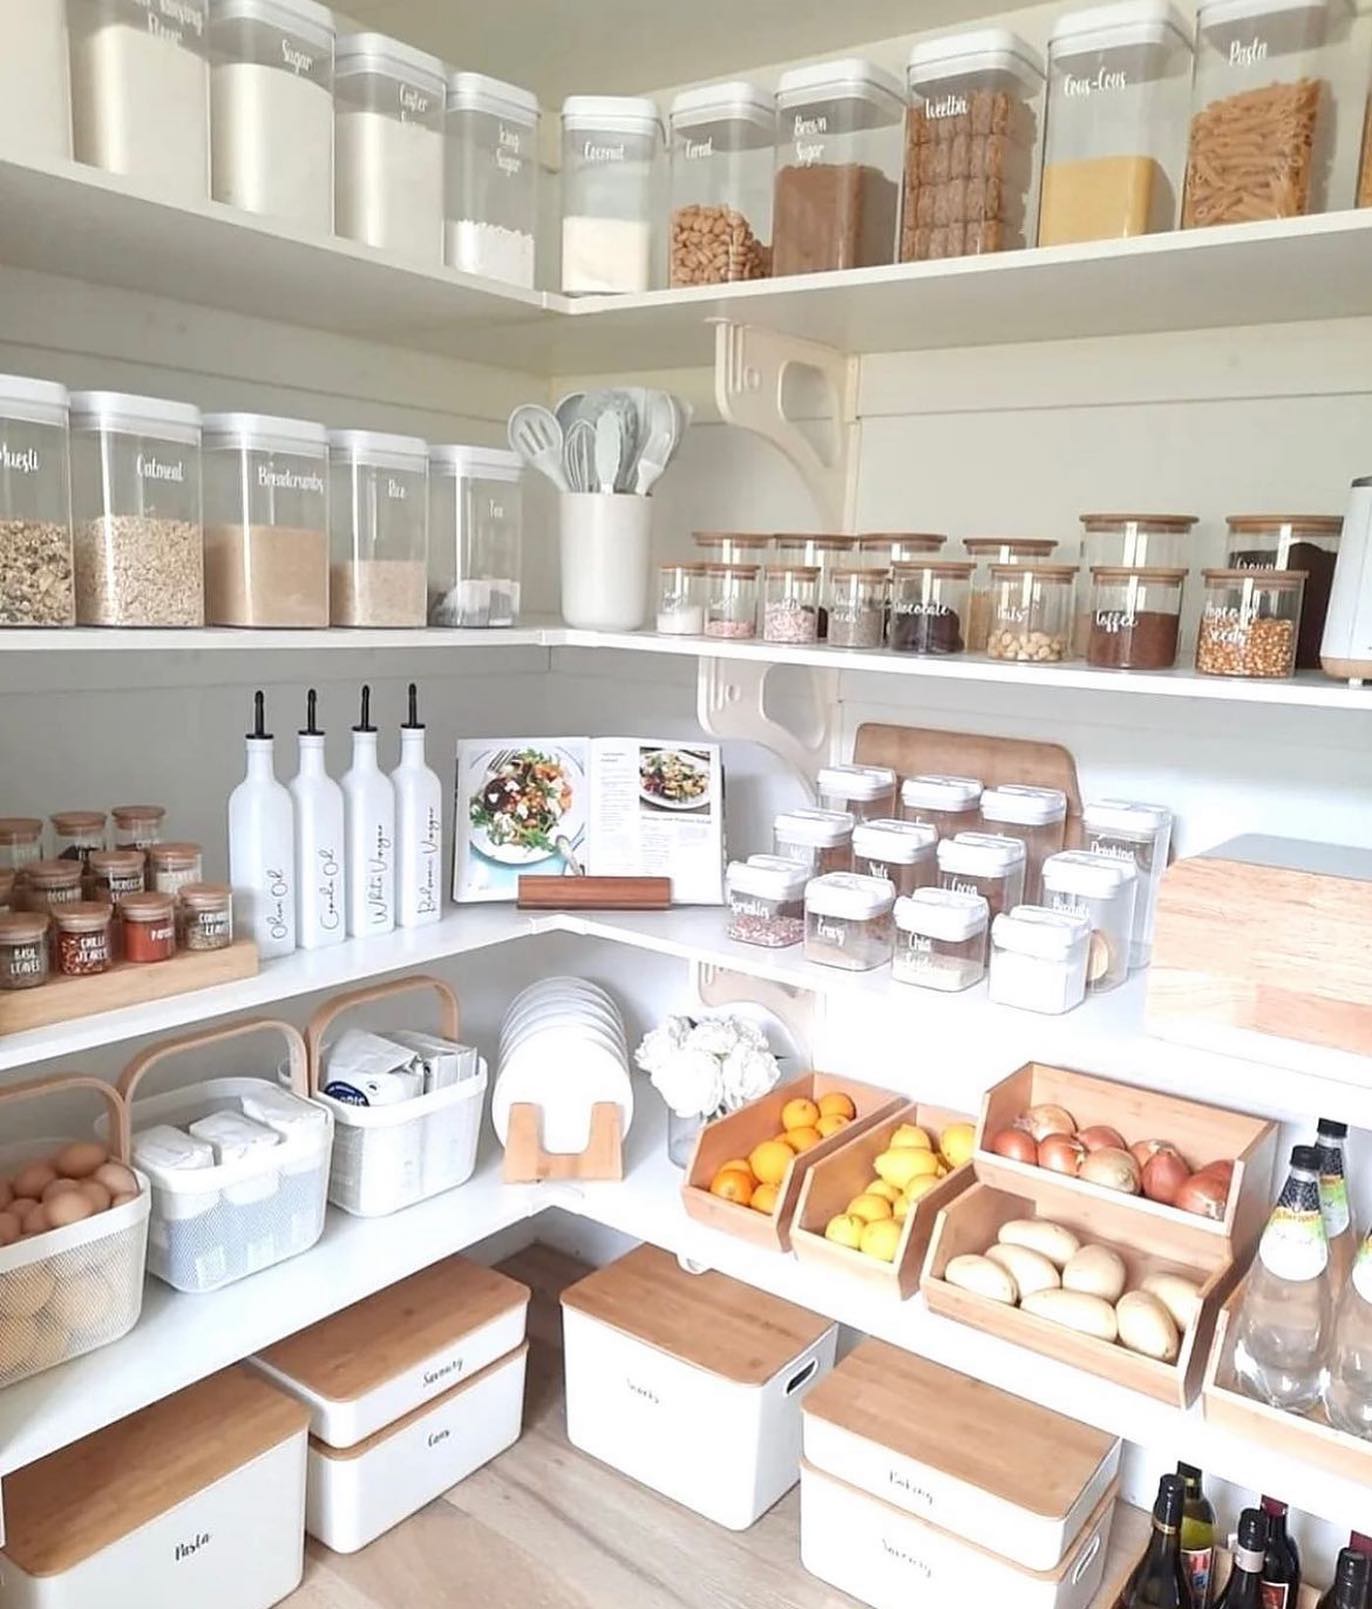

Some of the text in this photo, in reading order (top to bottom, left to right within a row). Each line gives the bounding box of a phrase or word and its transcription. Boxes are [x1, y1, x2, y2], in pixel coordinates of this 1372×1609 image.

[282, 38, 313, 73] Sugar
[1229, 37, 1268, 67] Pasta
[1064, 66, 1127, 97] Cous-Cous
[584, 141, 625, 161] Coconut
[388, 478, 407, 500] Rice
[318, 847, 340, 877] Oil
[266, 868, 289, 898] Oil
[10, 958, 41, 975] LEAVES
[174, 1532, 211, 1561] Pasta
